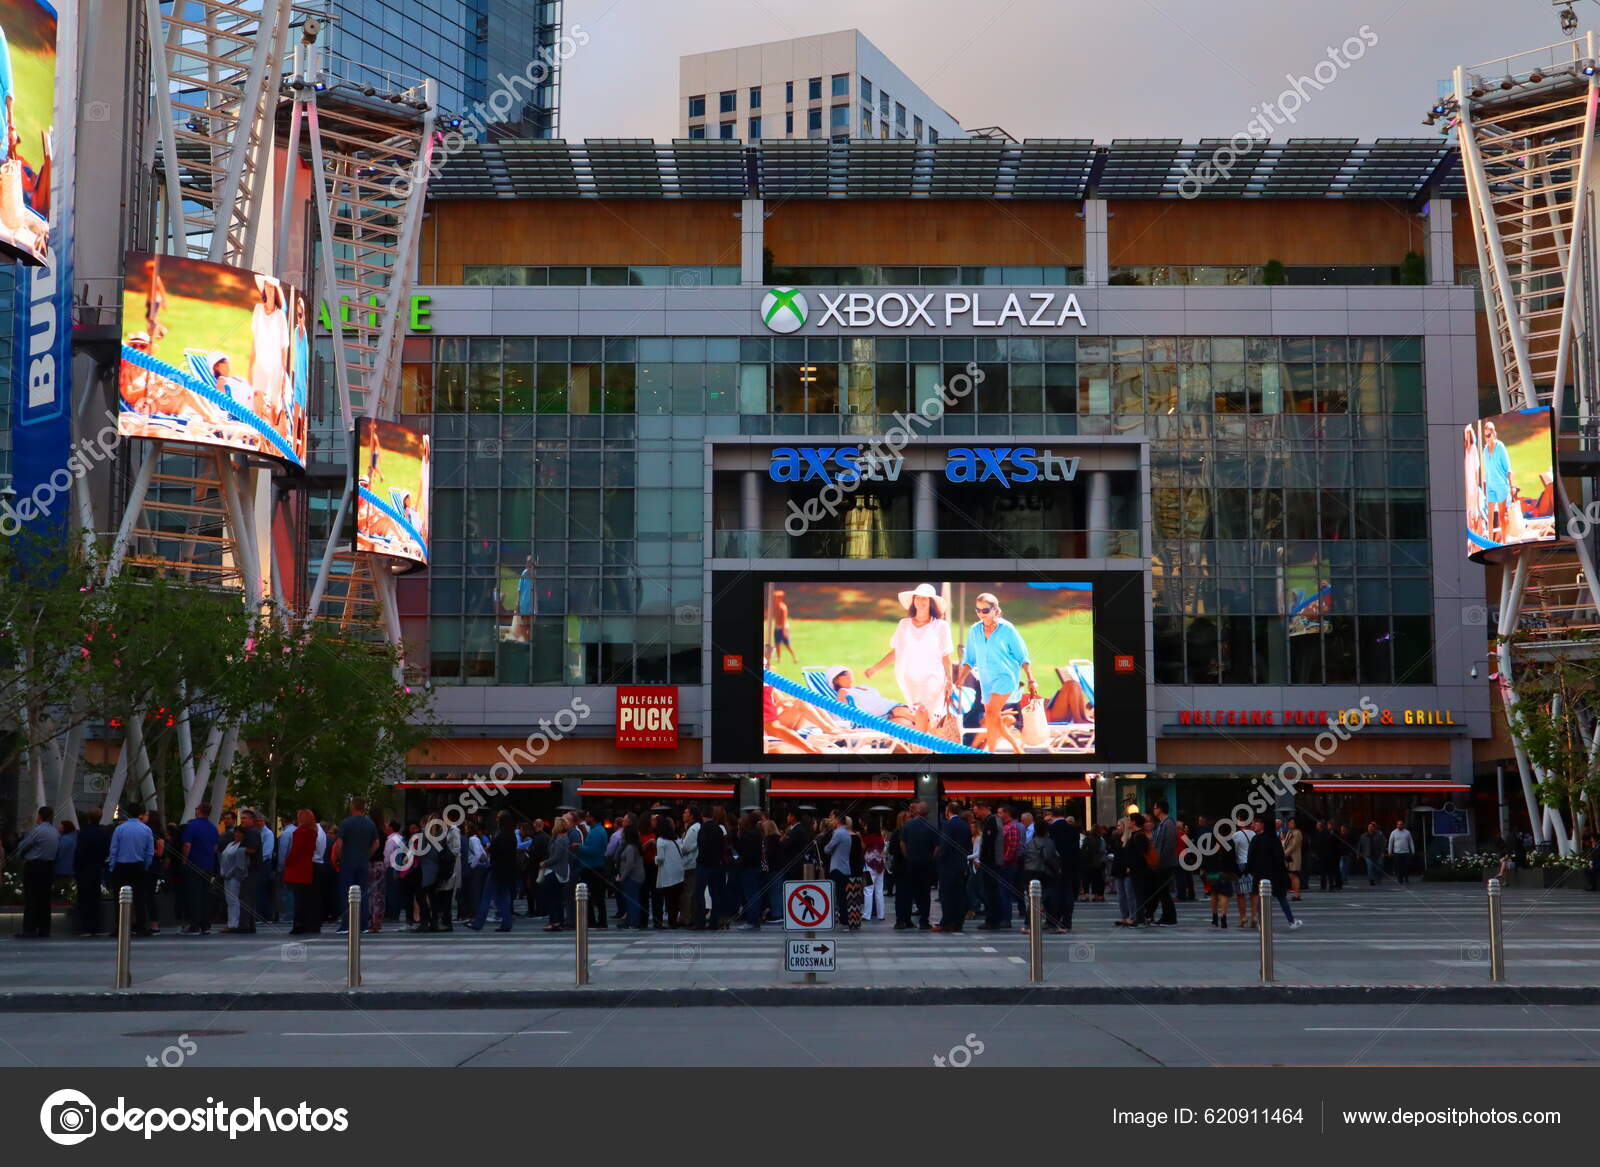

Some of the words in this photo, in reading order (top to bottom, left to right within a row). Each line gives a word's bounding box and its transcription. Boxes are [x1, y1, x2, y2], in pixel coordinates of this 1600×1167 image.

[817, 293, 936, 327] XBOX
[945, 293, 1087, 327] PLAZA
[620, 695, 673, 705] WOLFGANG
[620, 707, 674, 731] PUCK
[1179, 710, 1274, 725] WOLFGANG
[1283, 710, 1327, 725] PUCK
[1380, 709, 1394, 725] &
[1404, 709, 1454, 725] GRILL
[793, 944, 810, 954] USE
[790, 957, 833, 967] CROSSWALK
